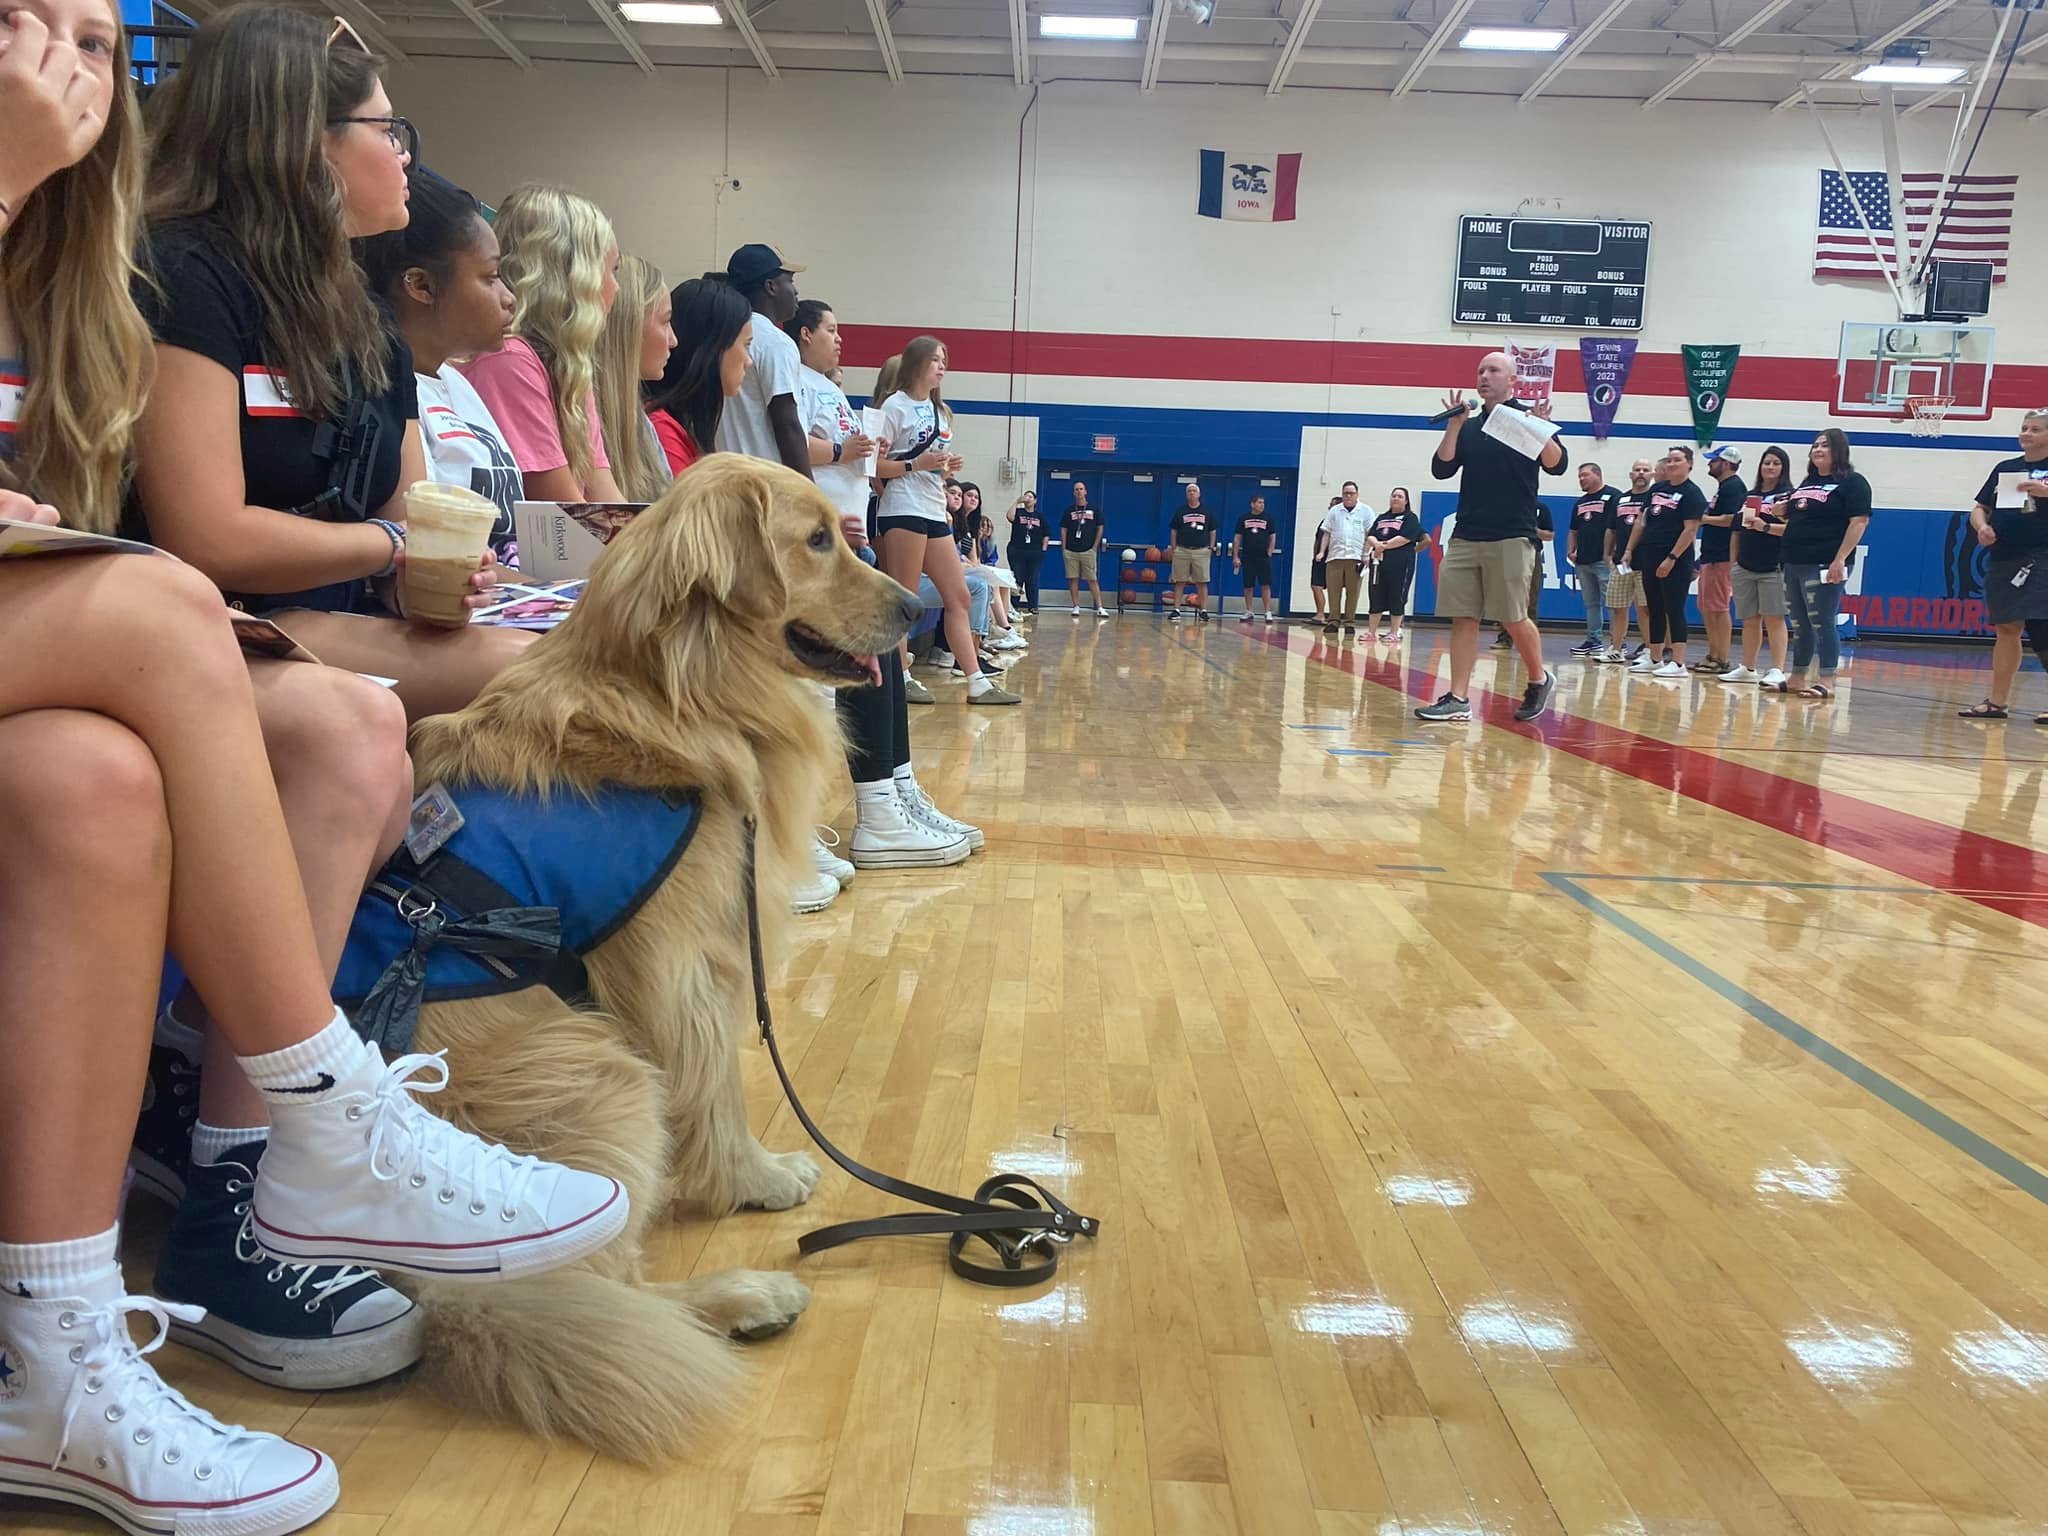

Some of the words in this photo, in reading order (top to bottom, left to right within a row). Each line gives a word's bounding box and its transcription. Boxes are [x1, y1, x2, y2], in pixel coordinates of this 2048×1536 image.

[1237, 199, 1260, 209] IOWA
[1469, 221, 1503, 234] HOME
[1604, 226, 1648, 239] VISITOR
[1480, 266, 1507, 276] BONUS
[1529, 262, 1560, 272] PERIOD
[1597, 271, 1625, 281] BONUS
[1463, 281, 1488, 291] FOULS
[1521, 283, 1551, 293] PLAYER
[1562, 285, 1587, 295] FOULS
[1614, 287, 1639, 297] FOULS
[1460, 312, 1487, 321] POINTS
[1496, 313, 1512, 322] TOL
[1540, 315, 1566, 324] MATCH
[1584, 316, 1600, 326] TOL
[1610, 317, 1636, 327] POINTS
[1596, 344, 1622, 352] TENNIS
[1597, 353, 1619, 361] STATE
[1701, 351, 1721, 359] GOLF
[1590, 362, 1625, 370] QUALIFIER
[1700, 360, 1721, 368] STATE
[1596, 371, 1616, 381] 2023
[1692, 369, 1727, 377] QUALIFIER
[1699, 379, 1719, 388] 2023
[554, 515, 569, 561] Kirkwood
